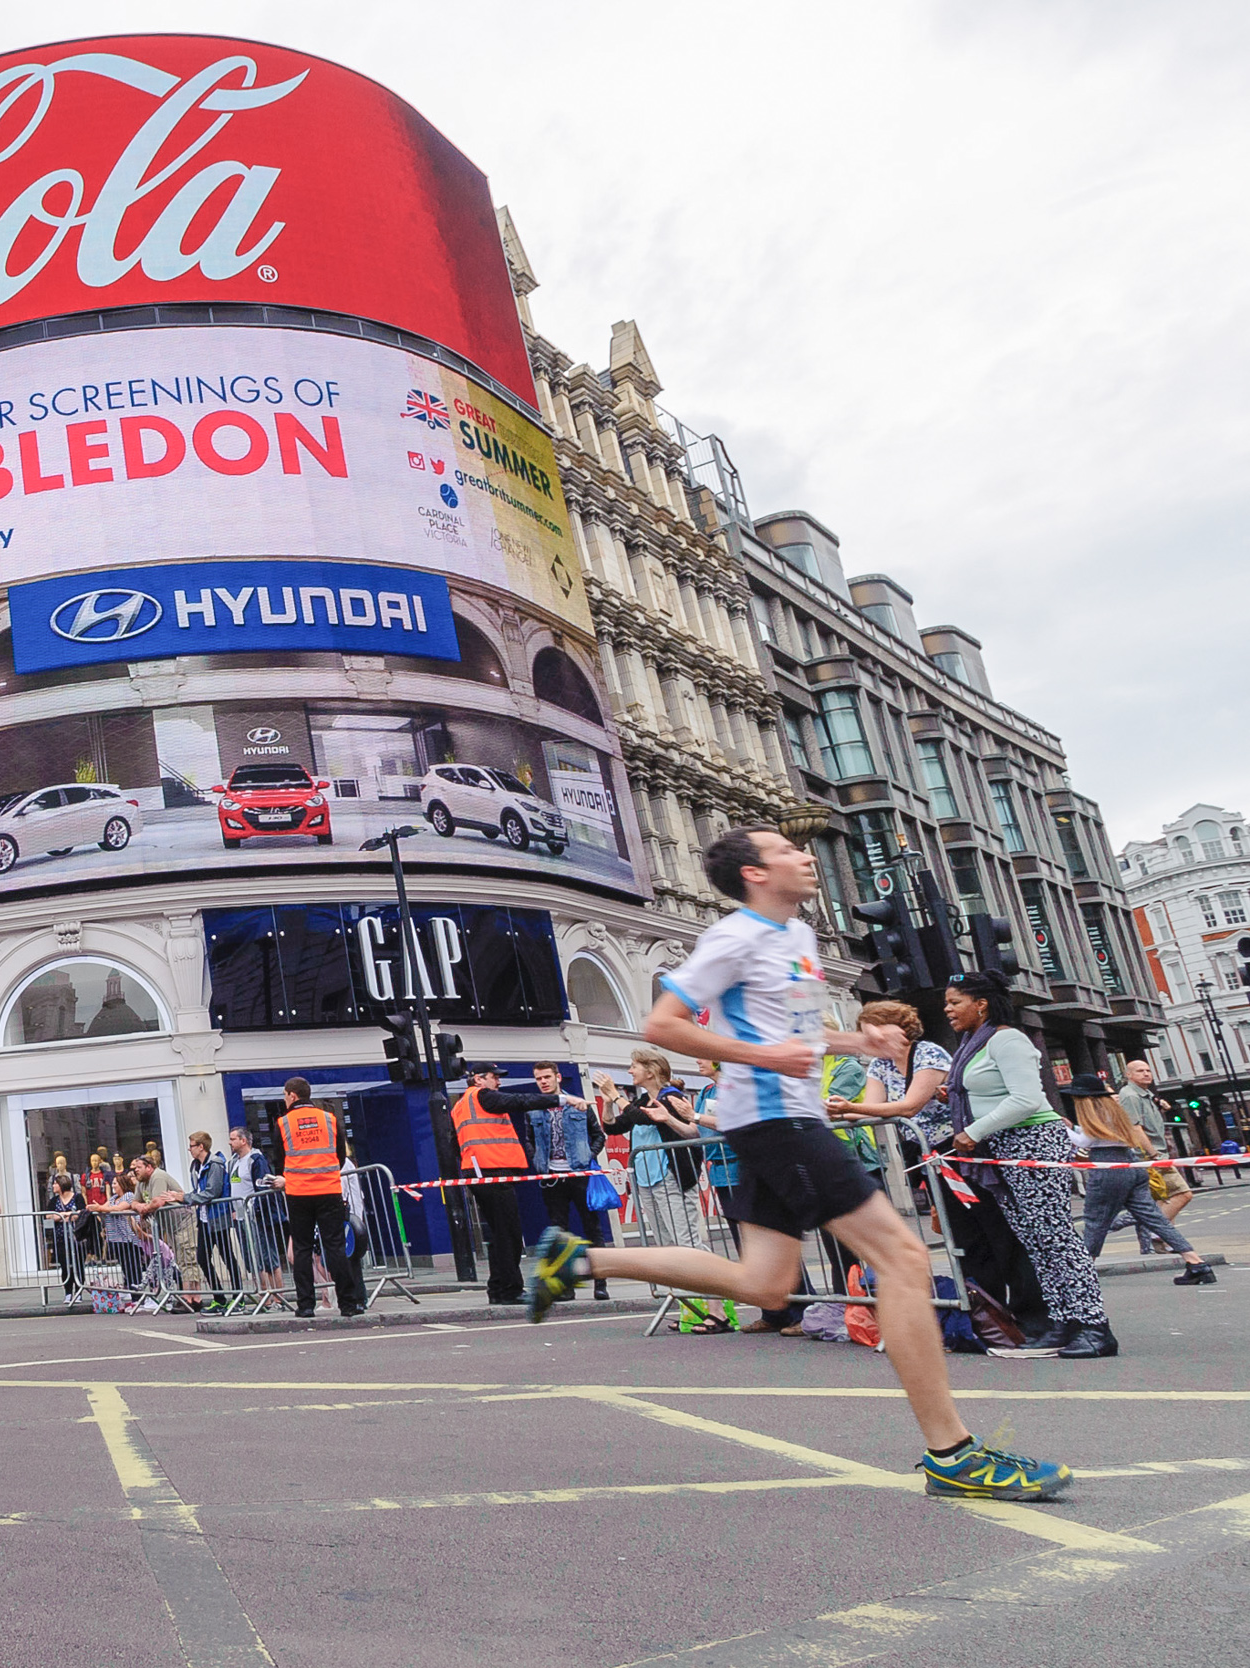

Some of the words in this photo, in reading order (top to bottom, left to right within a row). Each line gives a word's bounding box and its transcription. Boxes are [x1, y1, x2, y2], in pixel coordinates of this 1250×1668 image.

[29, 375, 284, 422] SCREENINGS
[294, 378, 341, 408] OF
[453, 398, 496, 433] GREAT
[459, 421, 554, 500] SUMMER
[417, 506, 465, 527] CARDINAL
[454, 470, 563, 538] greatbritsummer.com
[423, 528, 468, 548] VICTORIA
[429, 518, 459, 535] PLACE
[174, 586, 427, 632] HYUNDAI
[243, 745, 289, 755] HYUNDAI
[561, 787, 607, 813] HYUNDAI
[357, 916, 461, 1001] GAP
[295, 1129, 323, 1138] SECURITY
